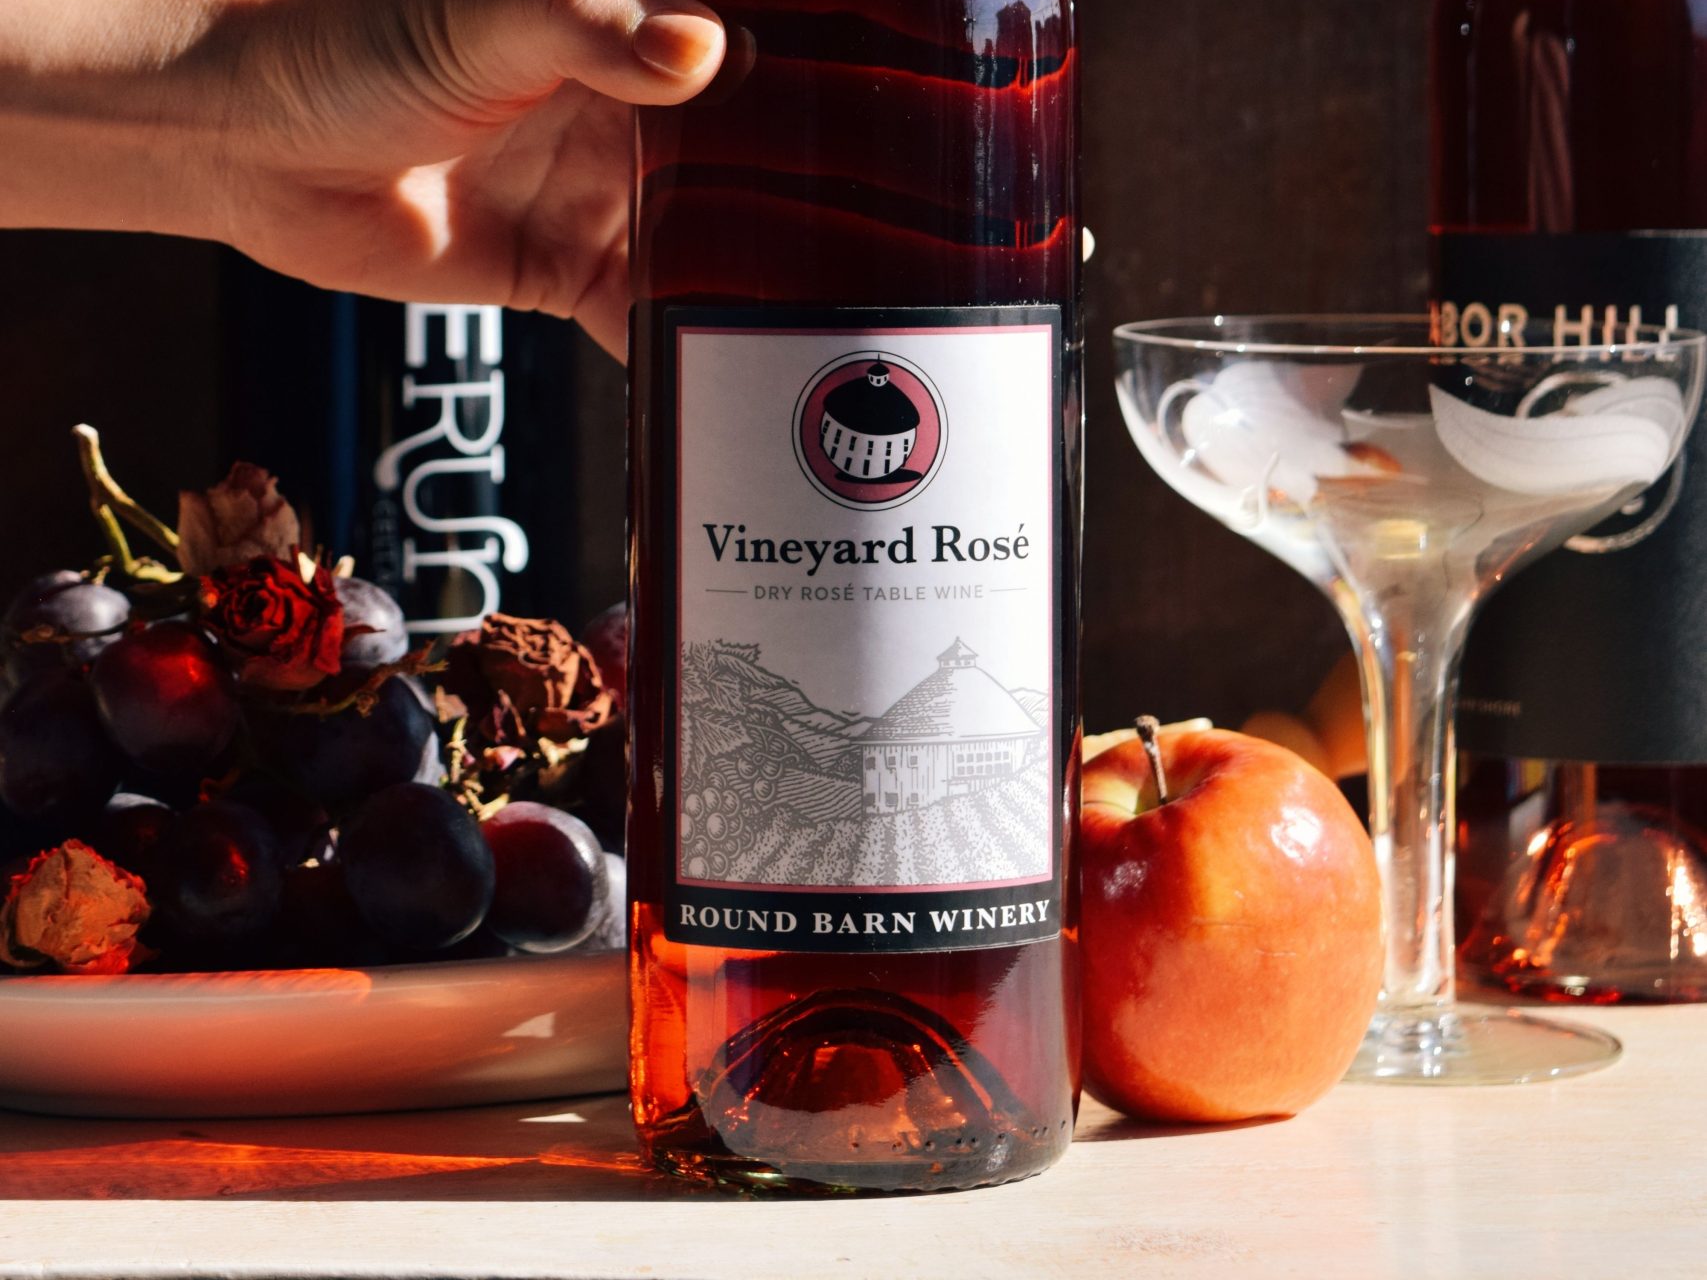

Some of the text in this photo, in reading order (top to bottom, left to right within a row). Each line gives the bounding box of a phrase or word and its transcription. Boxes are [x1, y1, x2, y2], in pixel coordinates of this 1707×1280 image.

[1552, 304, 1679, 364] HILL
[703, 523, 1029, 576] Vineyard Rosé
[754, 583, 984, 601] DRY ROSÉ TABLE WINE
[680, 899, 1050, 934] ROUND BARN WINERY
